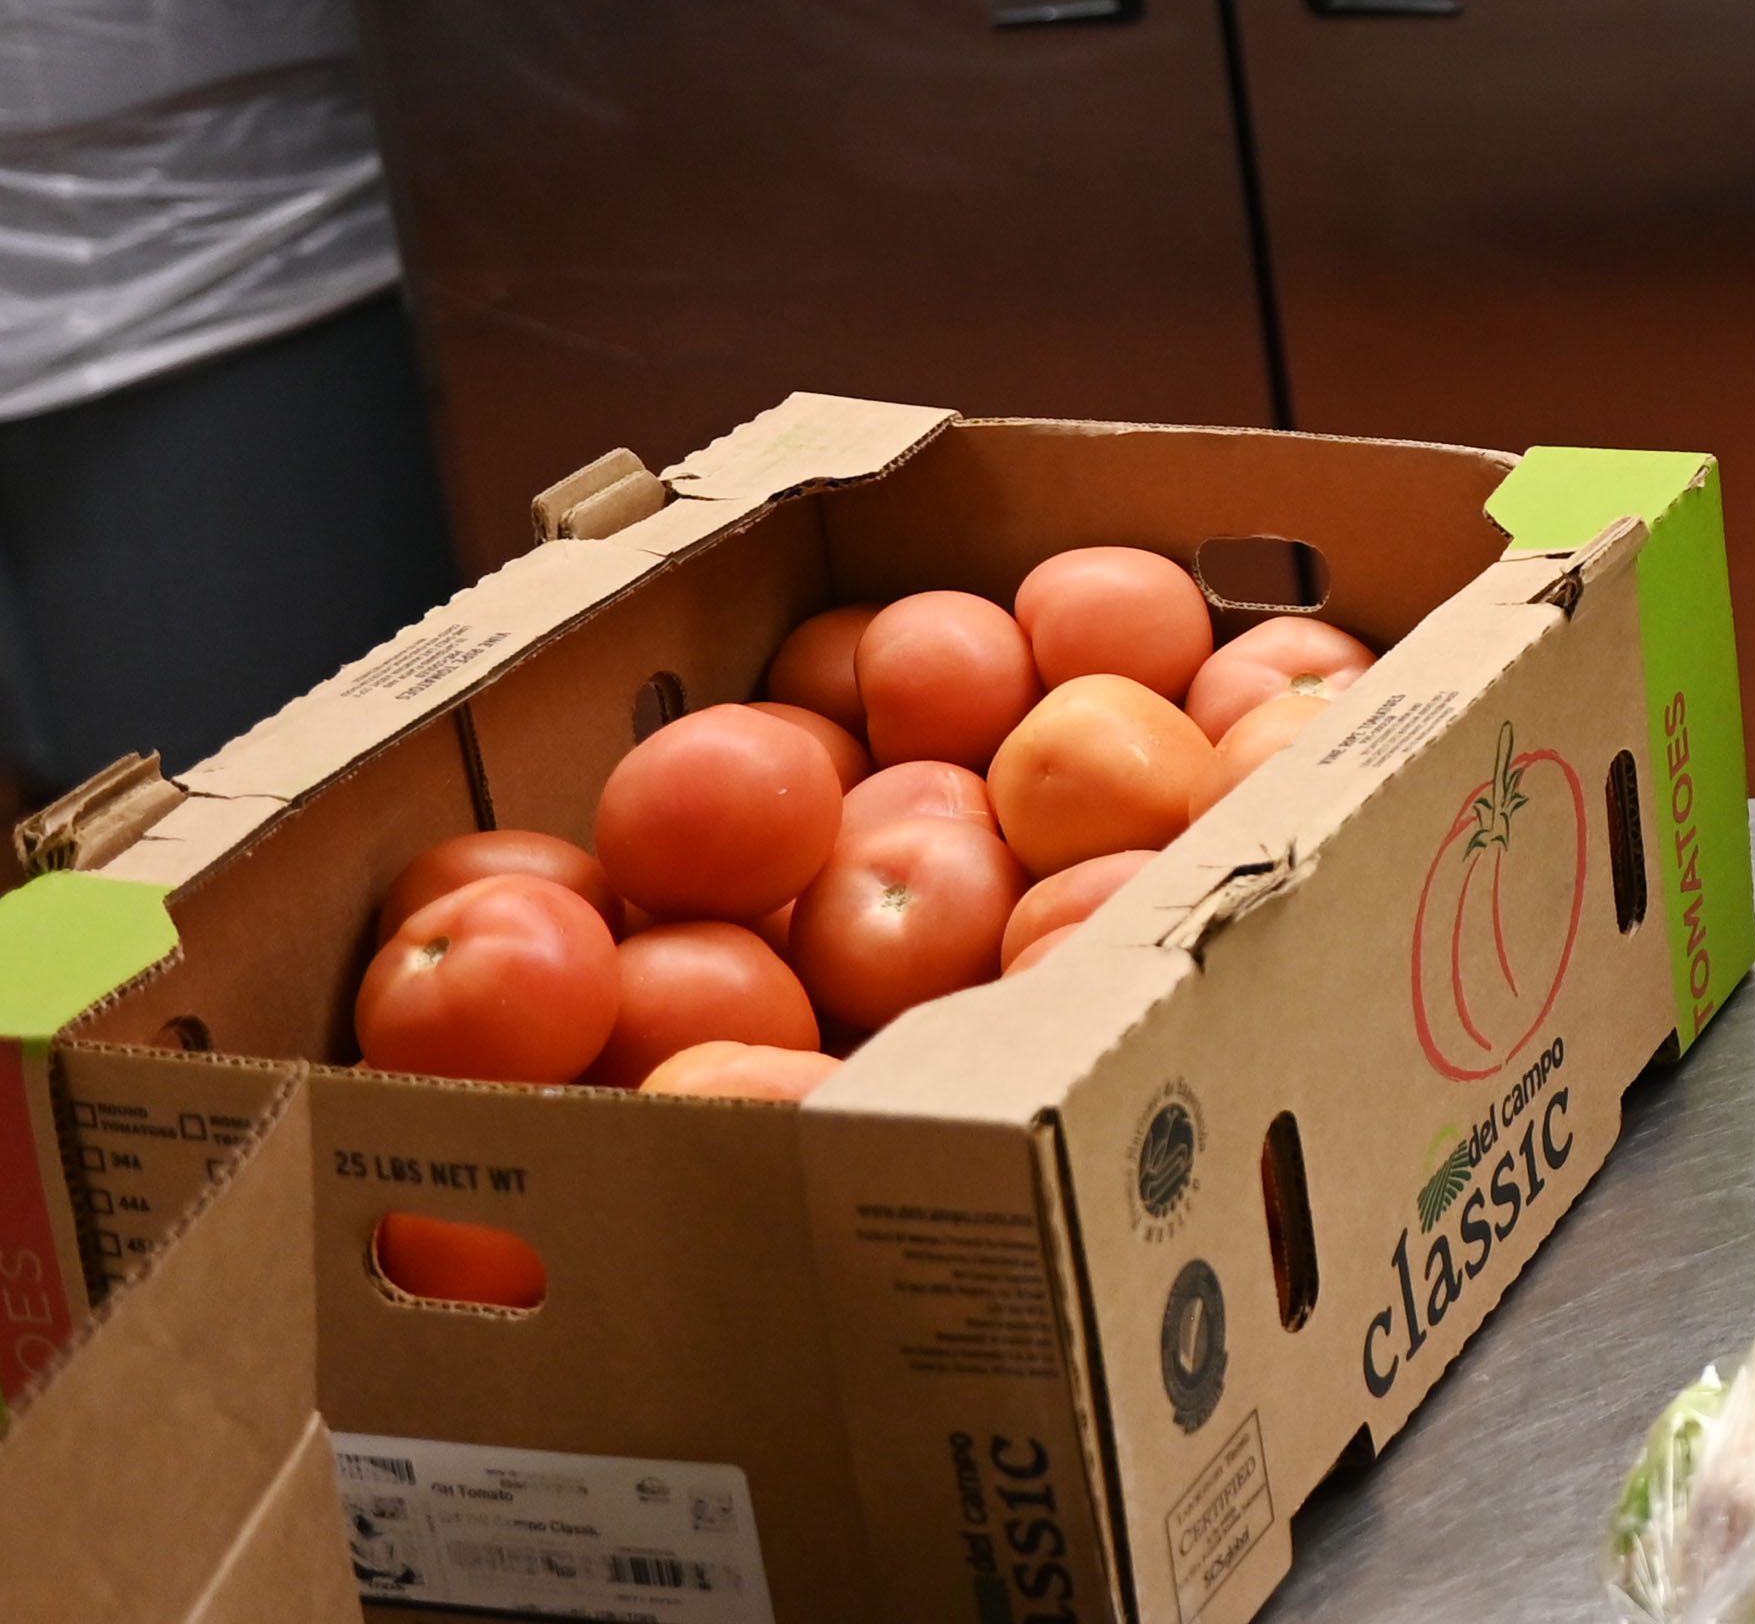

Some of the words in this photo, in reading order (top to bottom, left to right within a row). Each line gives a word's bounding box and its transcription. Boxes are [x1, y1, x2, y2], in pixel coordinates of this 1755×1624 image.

[1664, 691, 1714, 1036] TOMATOES
[103, 1120, 178, 1140] TOMATOES
[1467, 1103, 1499, 1169] del
[1501, 1037, 1564, 1128] campo
[335, 1150, 367, 1178] 25
[375, 1156, 423, 1184] LBS
[429, 1161, 478, 1191] NET
[489, 1167, 528, 1193] WT
[1363, 1087, 1573, 1398] classic
[458, 1484, 515, 1503] Tomato
[1178, 1455, 1257, 1557] CERTIFIED
